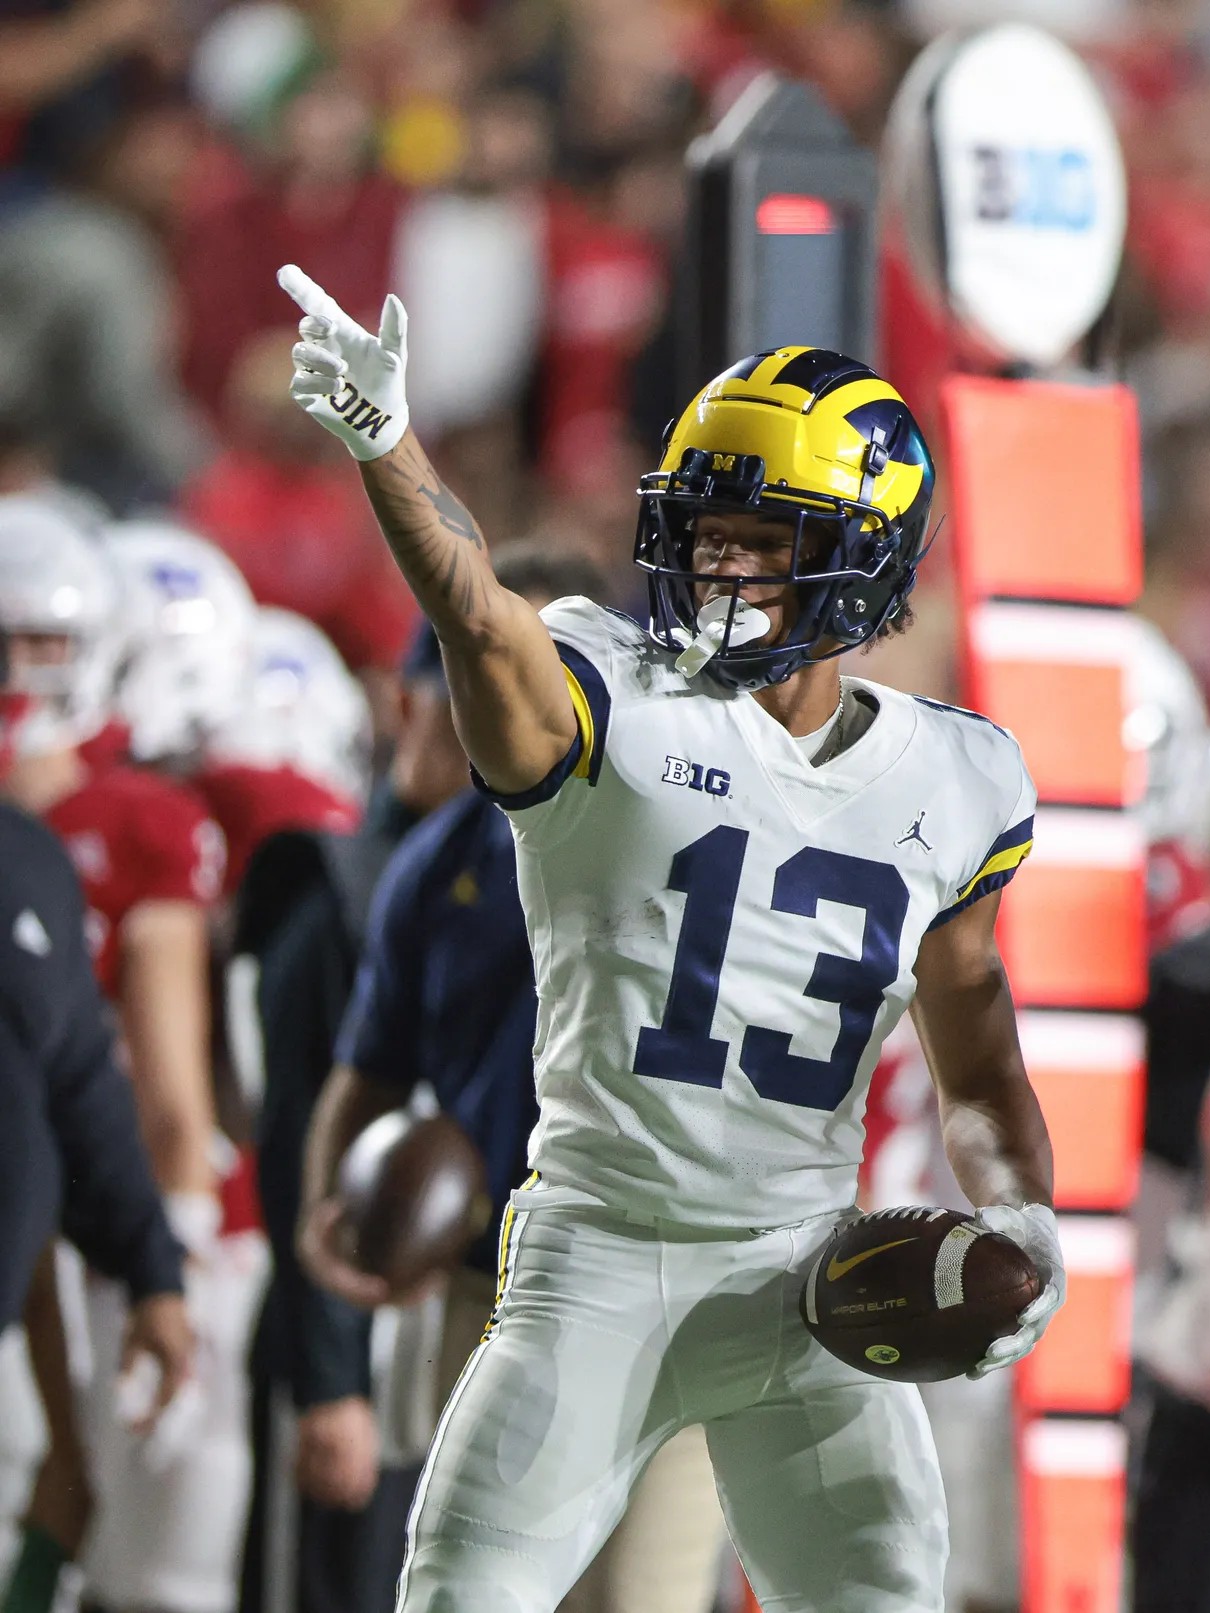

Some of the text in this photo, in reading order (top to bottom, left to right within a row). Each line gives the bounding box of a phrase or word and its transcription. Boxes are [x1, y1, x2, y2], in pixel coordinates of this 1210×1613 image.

[326, 382, 393, 440] MIC
[712, 453, 735, 472] M
[632, 824, 910, 1111] 13
